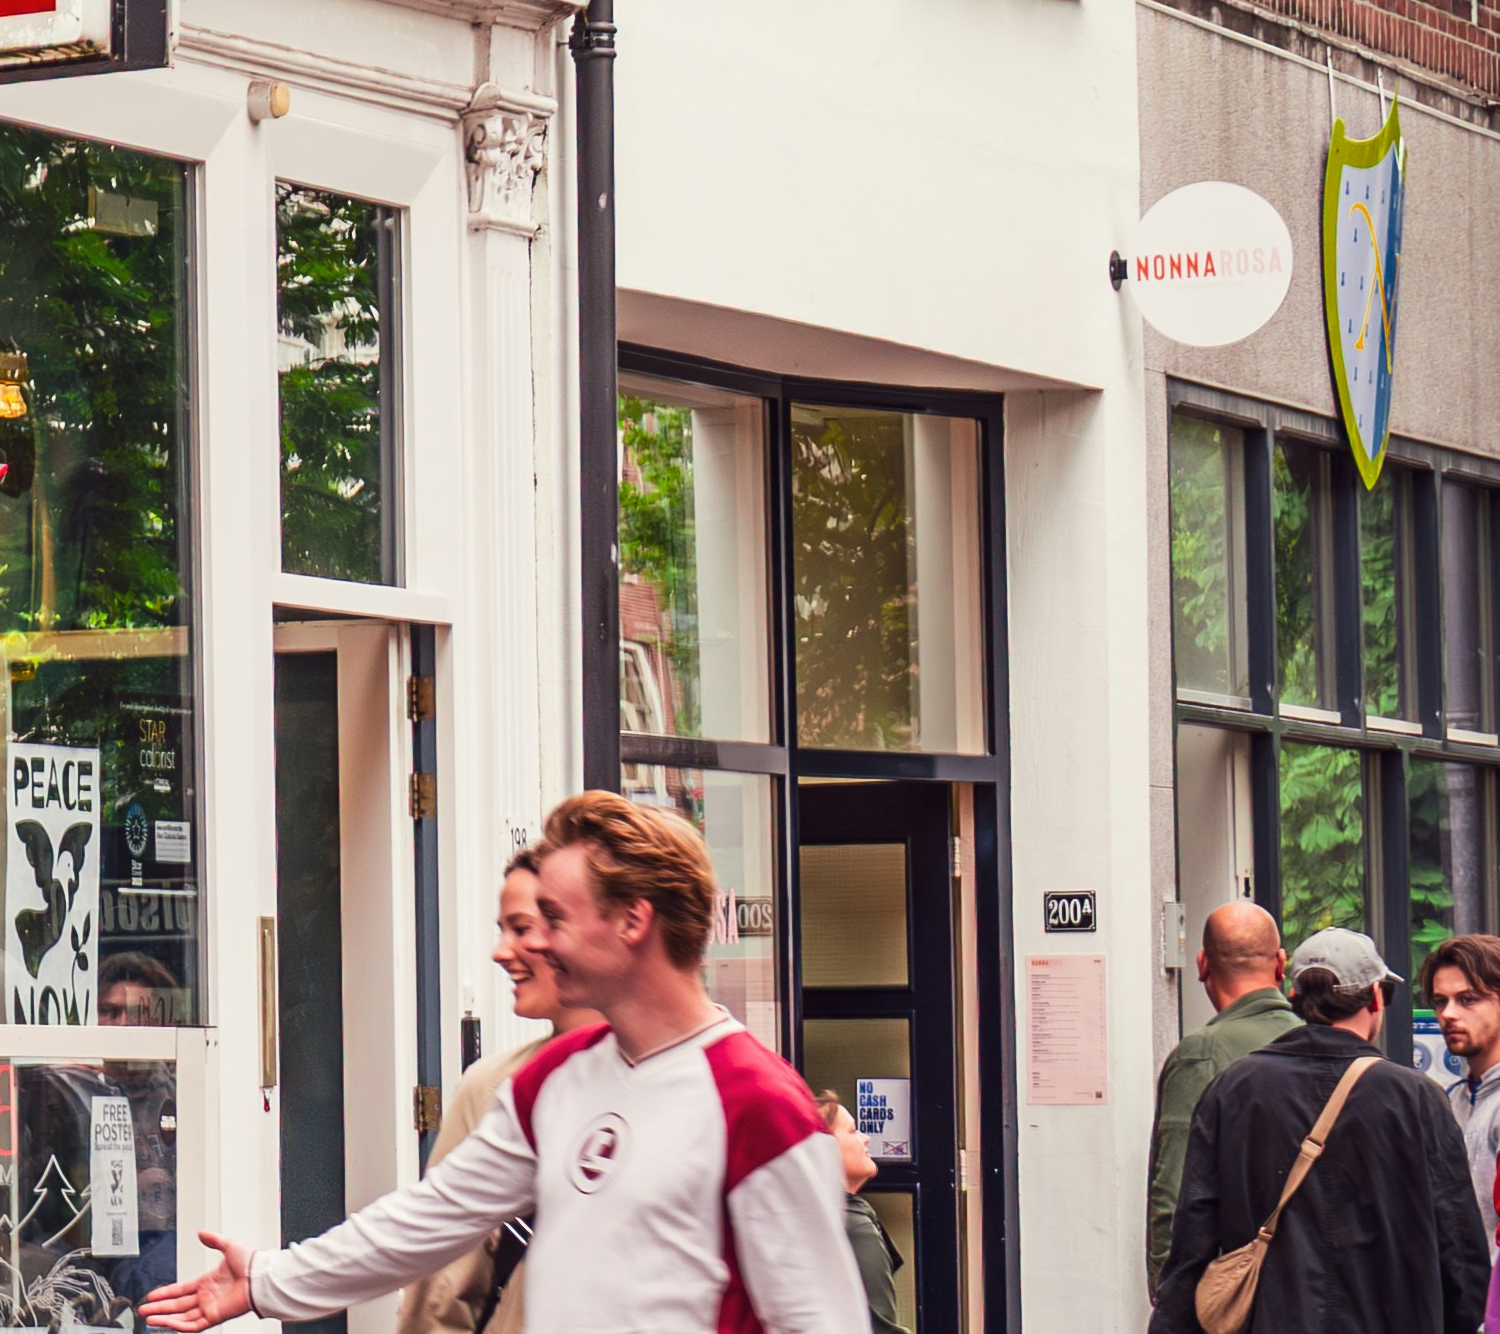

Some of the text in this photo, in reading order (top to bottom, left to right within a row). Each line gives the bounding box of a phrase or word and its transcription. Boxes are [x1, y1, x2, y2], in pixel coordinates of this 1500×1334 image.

[139, 720, 167, 746] STAR
[13, 756, 93, 812] PEACE
[510, 827, 528, 853] 198
[1048, 898, 1094, 929] 200A
[13, 985, 90, 1026] NOW
[860, 1080, 874, 1094] NO
[860, 1094, 888, 1107] CASH
[102, 1103, 128, 1122] FREE
[860, 1107, 896, 1121] CARDS
[860, 1120, 886, 1134] ONLY
